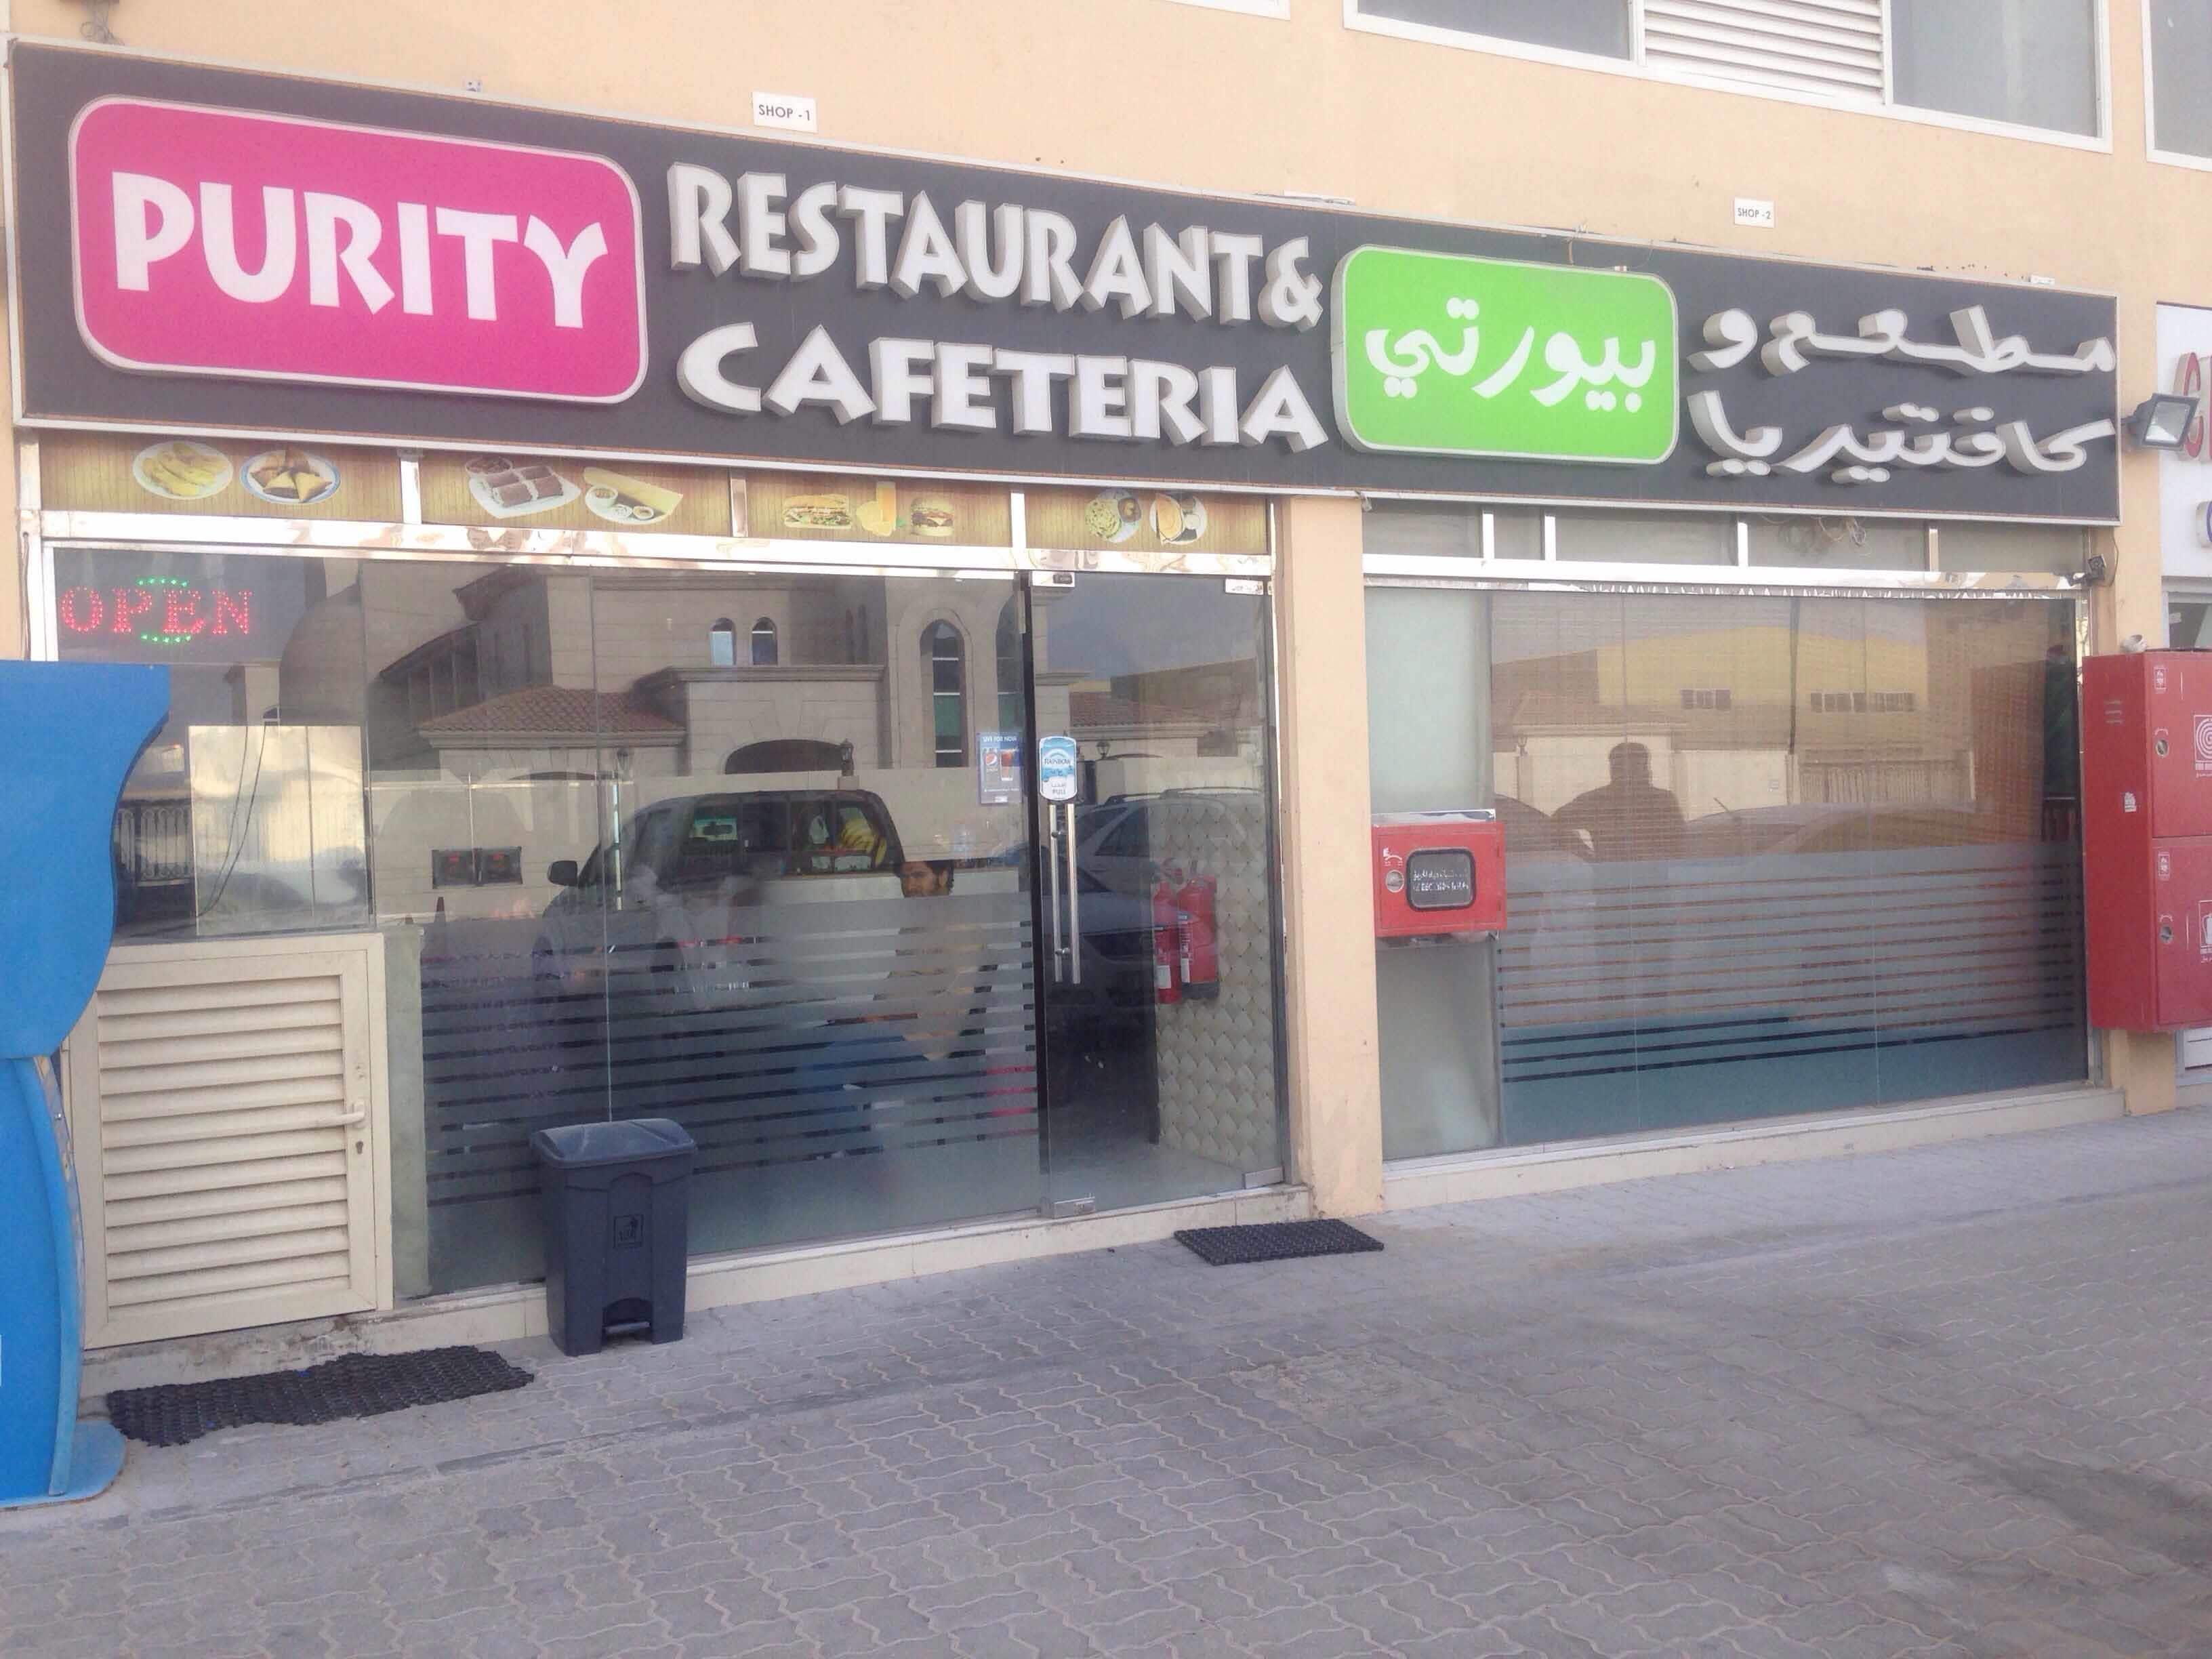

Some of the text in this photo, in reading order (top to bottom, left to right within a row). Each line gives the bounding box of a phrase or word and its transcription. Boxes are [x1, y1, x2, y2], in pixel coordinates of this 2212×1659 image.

[758, 104, 794, 119] SHOP
[1737, 207, 1760, 218] SHOP
[111, 171, 609, 329] PURITY
[1364, 296, 1656, 413] بيورتي
[1761, 304, 2116, 378] مطعم
[676, 321, 1329, 453] CAFETERIA
[1686, 389, 2116, 484] كافتيريا
[60, 586, 254, 635] OPEN
[1044, 758, 1071, 766] RAINBOW
